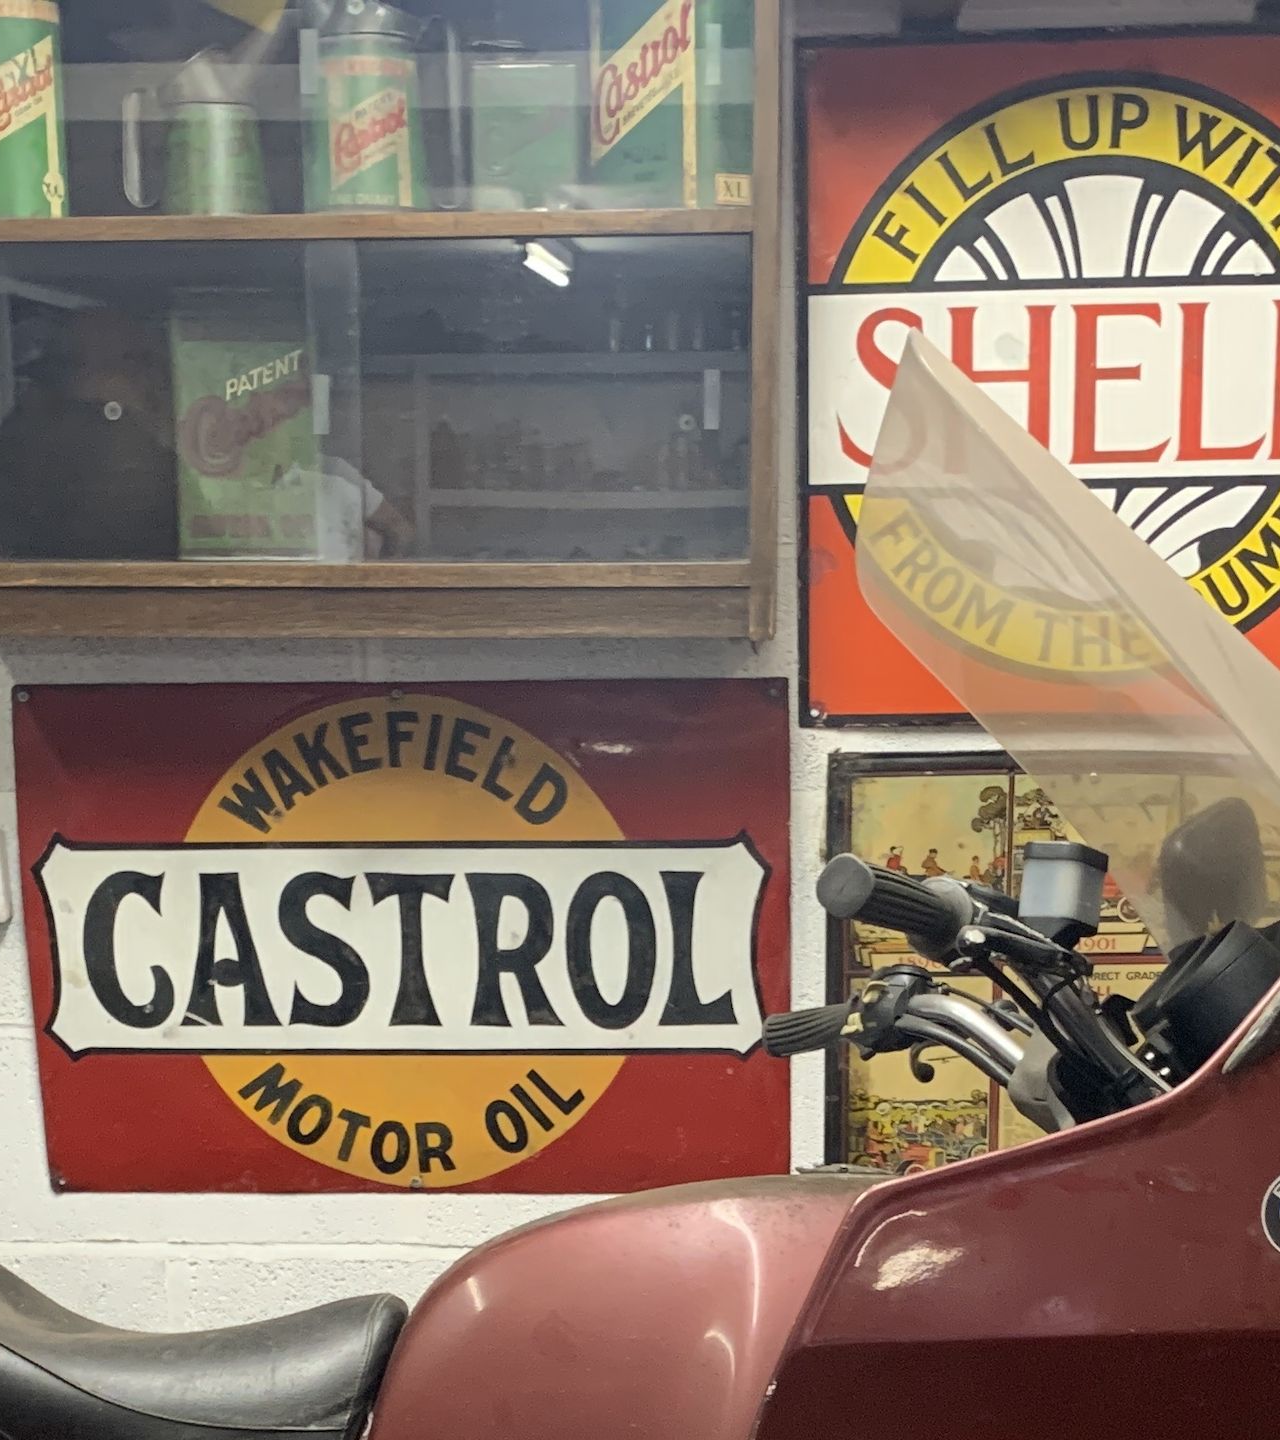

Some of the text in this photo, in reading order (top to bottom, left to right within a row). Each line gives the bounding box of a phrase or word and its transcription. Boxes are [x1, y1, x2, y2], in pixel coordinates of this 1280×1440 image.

[593, 2, 692, 145] Castrol
[722, 179, 747, 200] XL
[872, 125, 1037, 264] FILL
[1056, 95, 1150, 152] UP
[225, 349, 303, 401] PATENT
[868, 507, 1016, 648] FROM
[219, 710, 570, 834] WAKEFIELD
[82, 869, 740, 1031] CASTROL
[238, 1061, 587, 1175] MOTOR OIL
